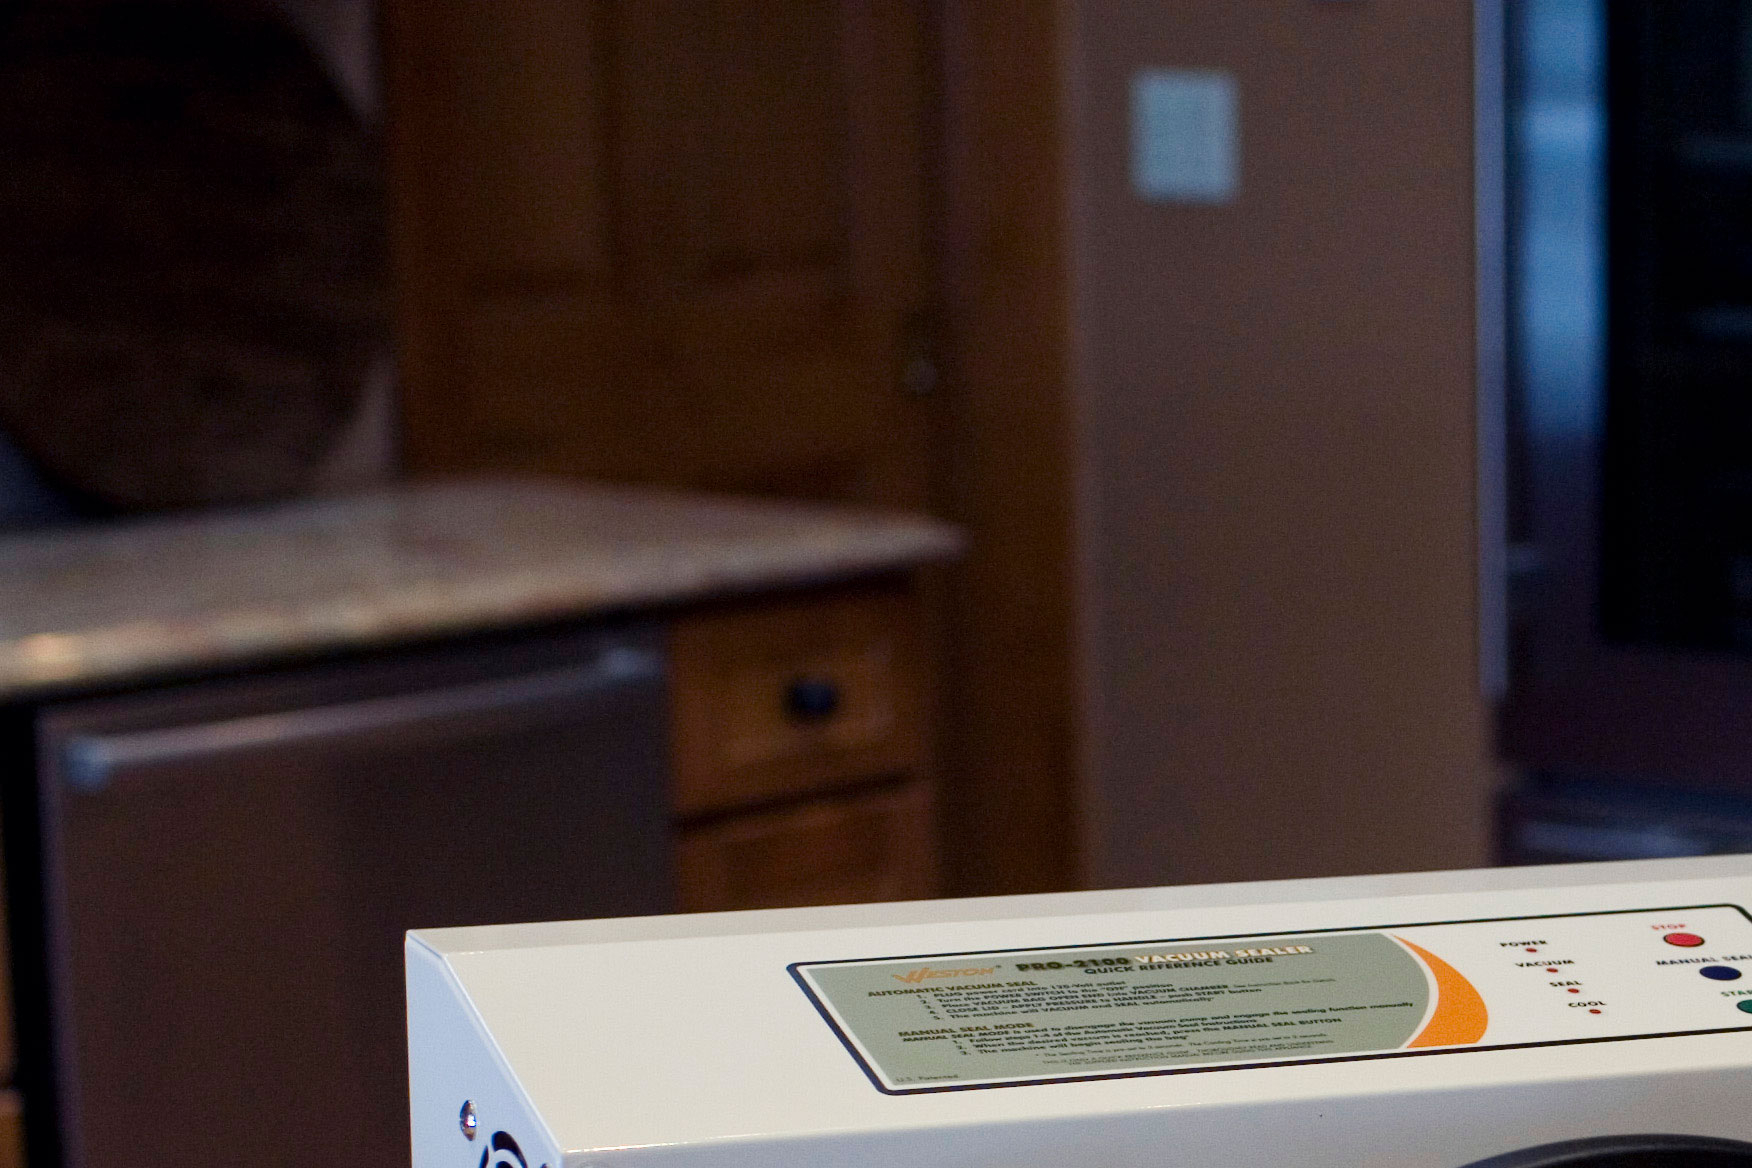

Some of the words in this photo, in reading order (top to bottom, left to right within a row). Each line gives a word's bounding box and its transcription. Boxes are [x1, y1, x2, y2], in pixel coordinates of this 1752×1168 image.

[1016, 958, 1130, 972] PRO-2100
[1135, 951, 1231, 963] VACUUM
[1235, 945, 1313, 956] SEALER
[1084, 966, 1134, 974] QUICK
[1139, 960, 1220, 971] REFERENCE
[1225, 956, 1272, 965] GUIDE
[868, 987, 944, 996] AUTOMATIC
[946, 983, 1004, 991] VACUUM
[898, 1028, 956, 1036] MANUAL
